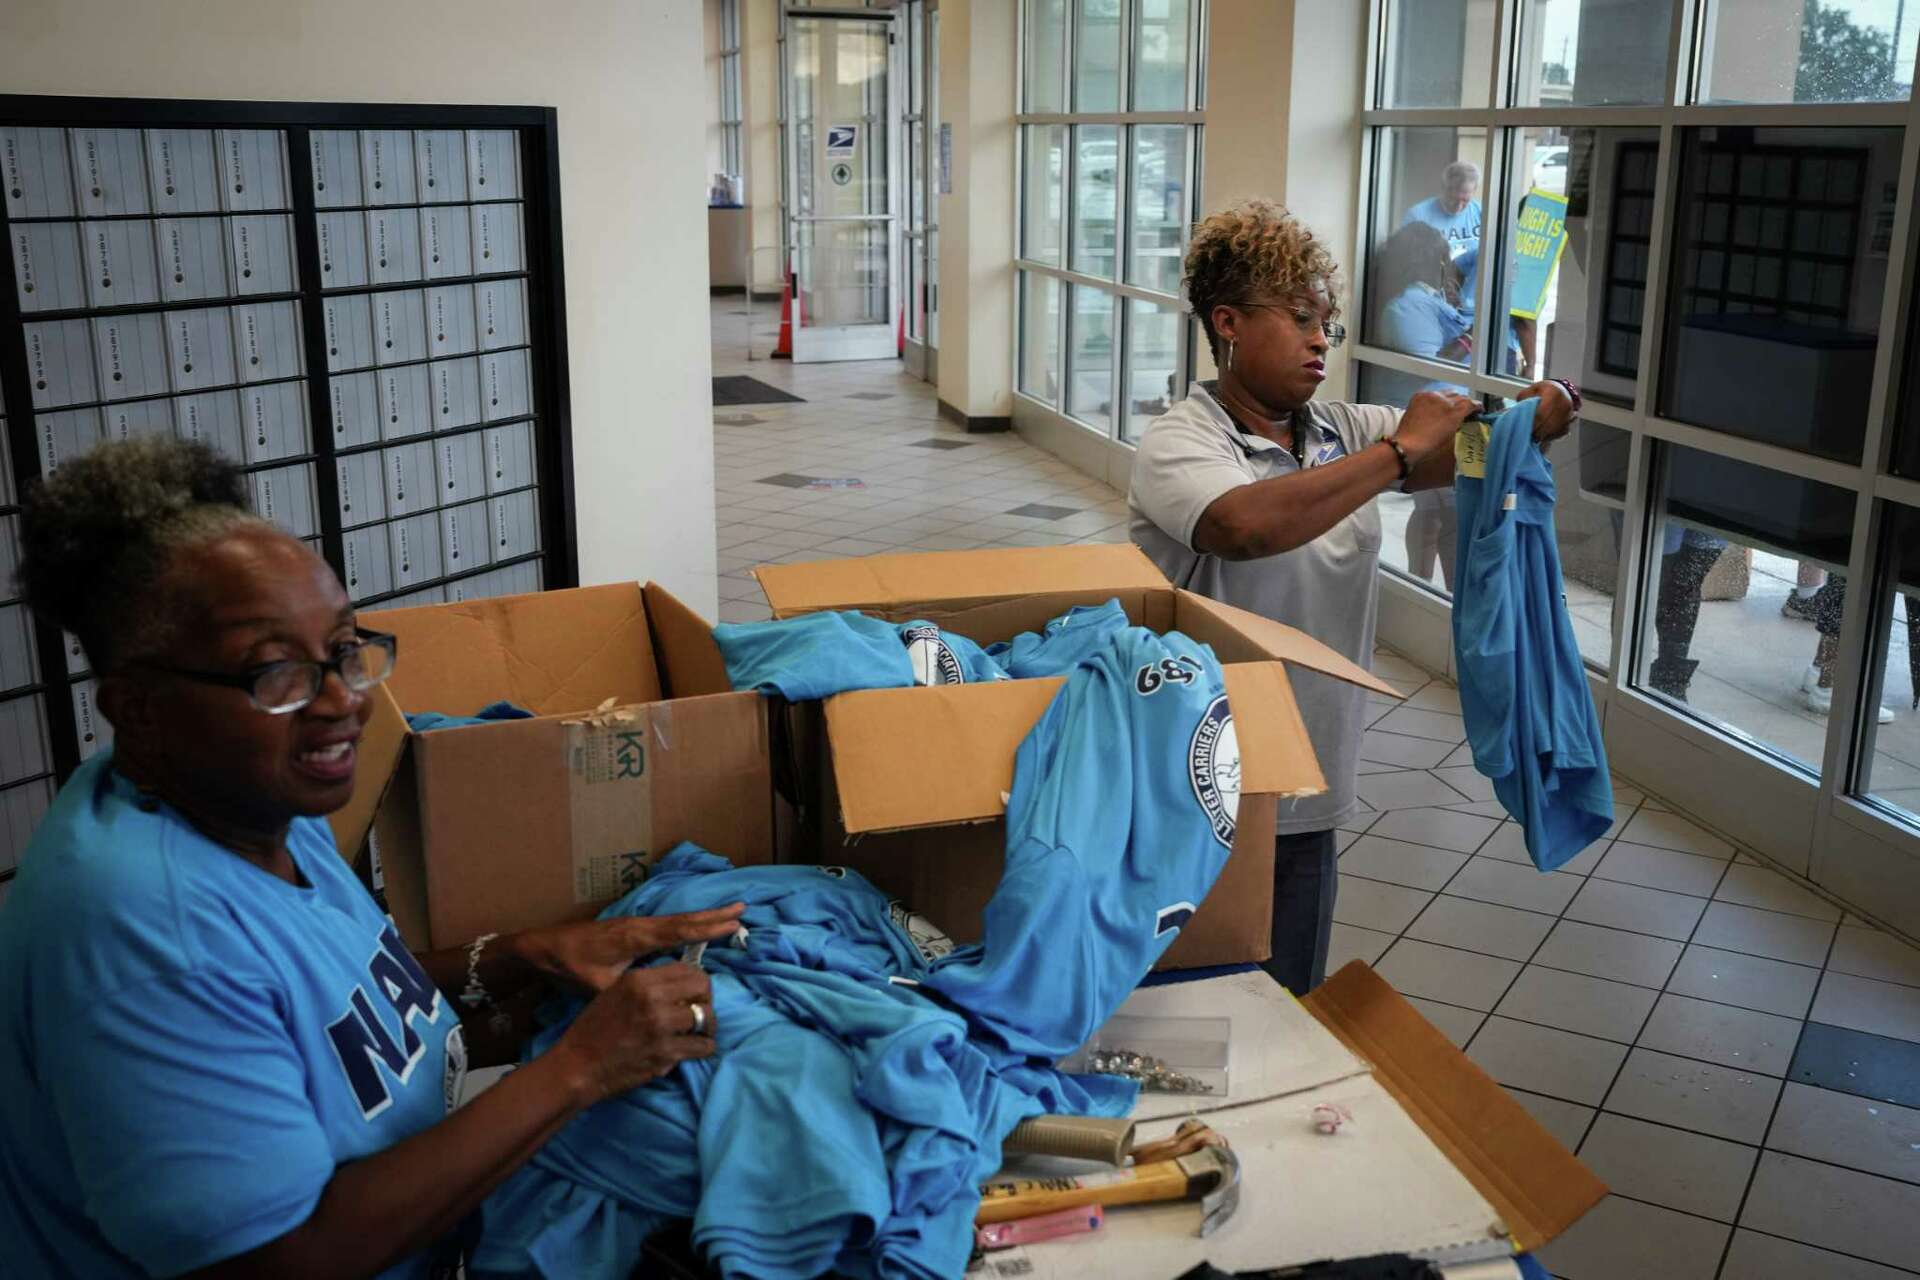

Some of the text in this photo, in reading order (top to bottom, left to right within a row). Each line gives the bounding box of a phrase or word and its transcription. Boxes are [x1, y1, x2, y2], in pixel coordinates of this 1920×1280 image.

[1441, 224, 1481, 241] ALC
[1520, 207, 1563, 238] UGH IS
[1516, 231, 1551, 260] UGH!
[616, 730, 644, 779] KR
[1194, 716, 1220, 786] CARRIERS
[324, 922, 442, 1121] NAL
